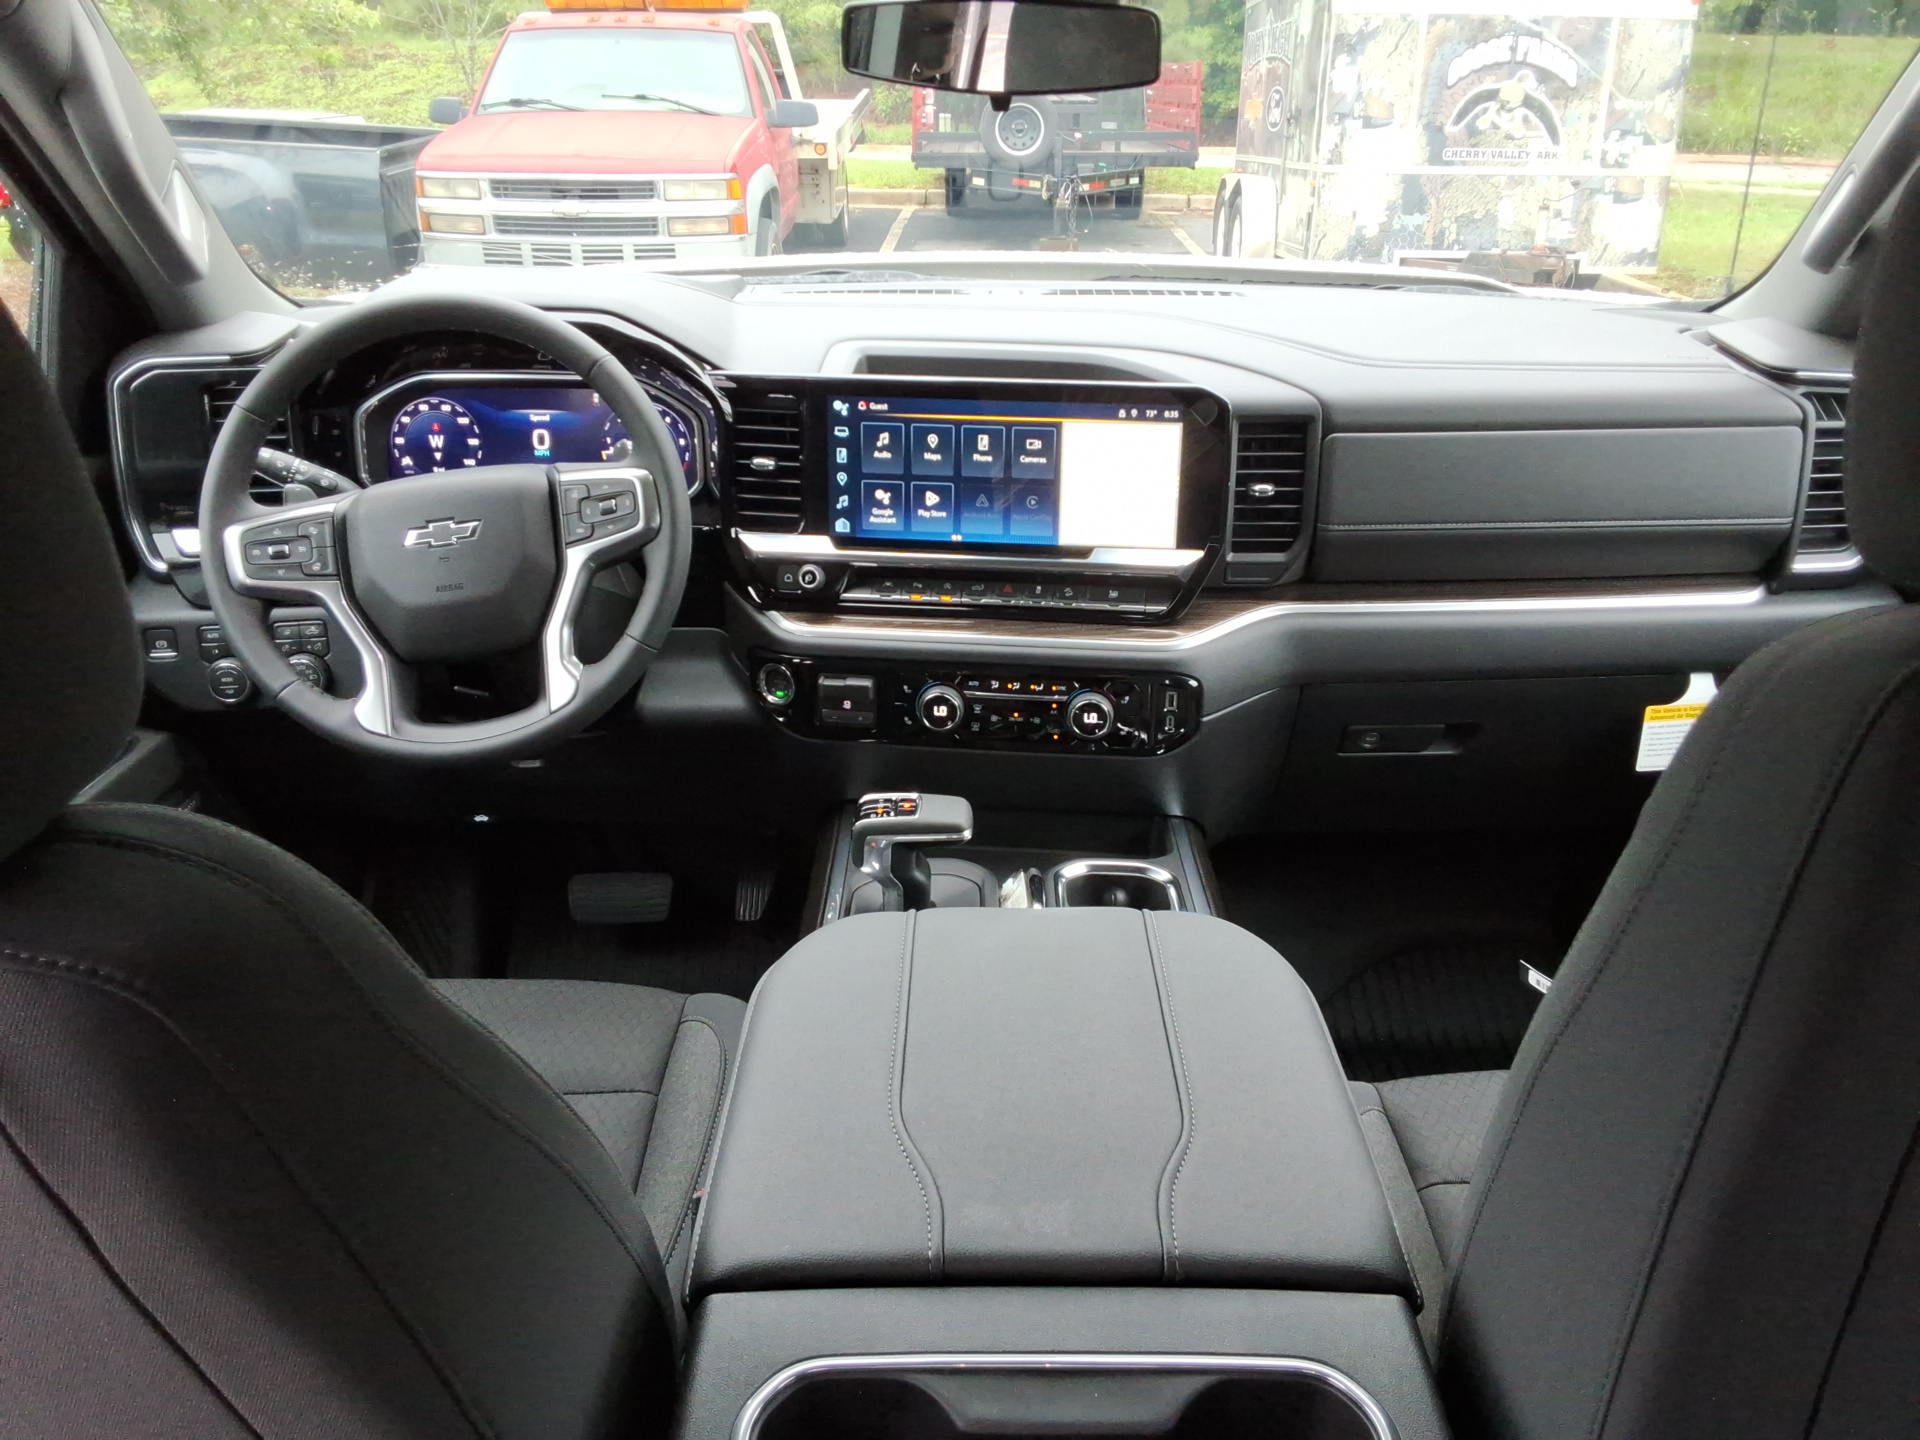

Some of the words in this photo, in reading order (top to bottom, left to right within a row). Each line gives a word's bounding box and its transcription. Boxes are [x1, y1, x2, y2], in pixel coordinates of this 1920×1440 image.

[1444, 150, 1487, 159] CHERRY
[1491, 150, 1531, 160] VALLEY
[869, 402, 888, 410] Guest
[529, 413, 550, 422] Speed
[428, 434, 444, 448] W
[532, 428, 550, 450] 0
[534, 449, 550, 457] MPH
[873, 450, 892, 458] Audio
[923, 452, 942, 461] Maps
[972, 453, 993, 462] Phone
[1020, 455, 1047, 464] Cameras
[871, 507, 894, 517] Google
[917, 509, 930, 518] Play
[931, 509, 947, 518] Store
[869, 516, 897, 524] Assistant
[933, 705, 948, 717] LO
[1083, 712, 1098, 724] LO
